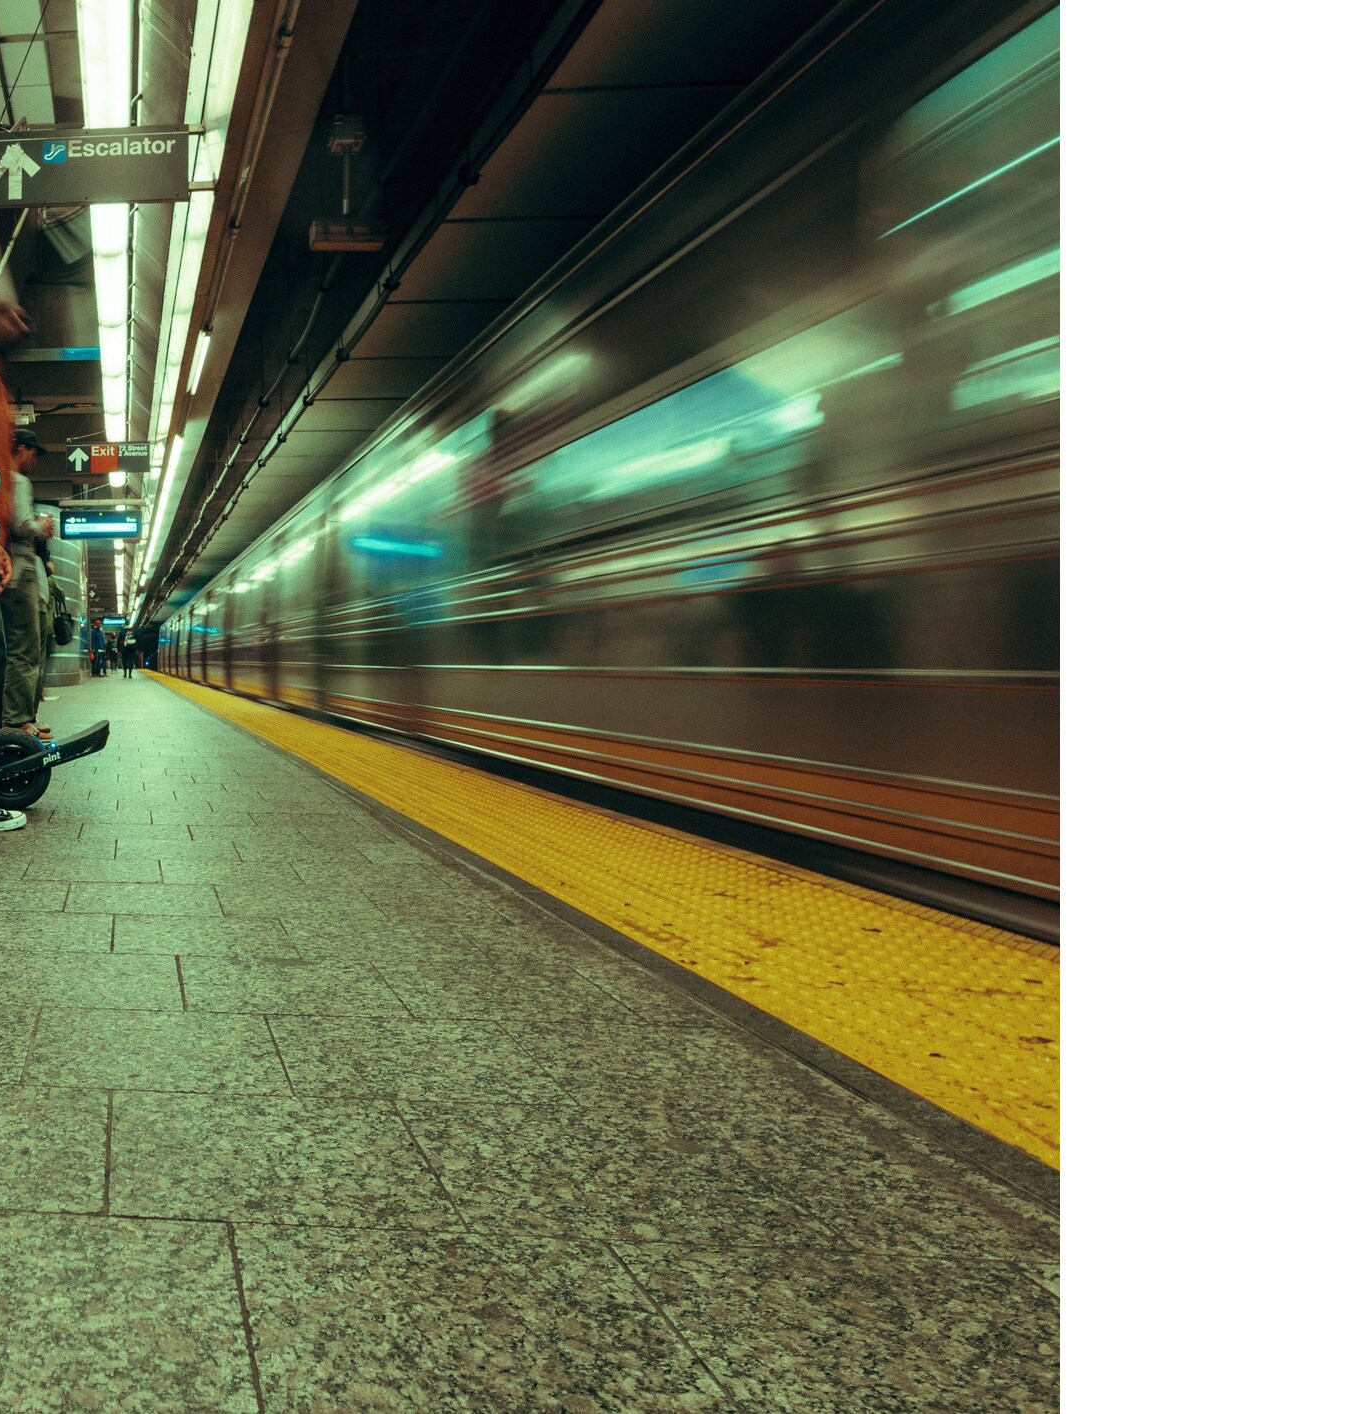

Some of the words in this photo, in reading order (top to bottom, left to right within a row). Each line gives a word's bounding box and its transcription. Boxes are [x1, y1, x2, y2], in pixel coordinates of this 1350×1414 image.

[68, 138, 176, 158] Escalator
[91, 446, 115, 456] Exit
[42, 751, 61, 765] pint
